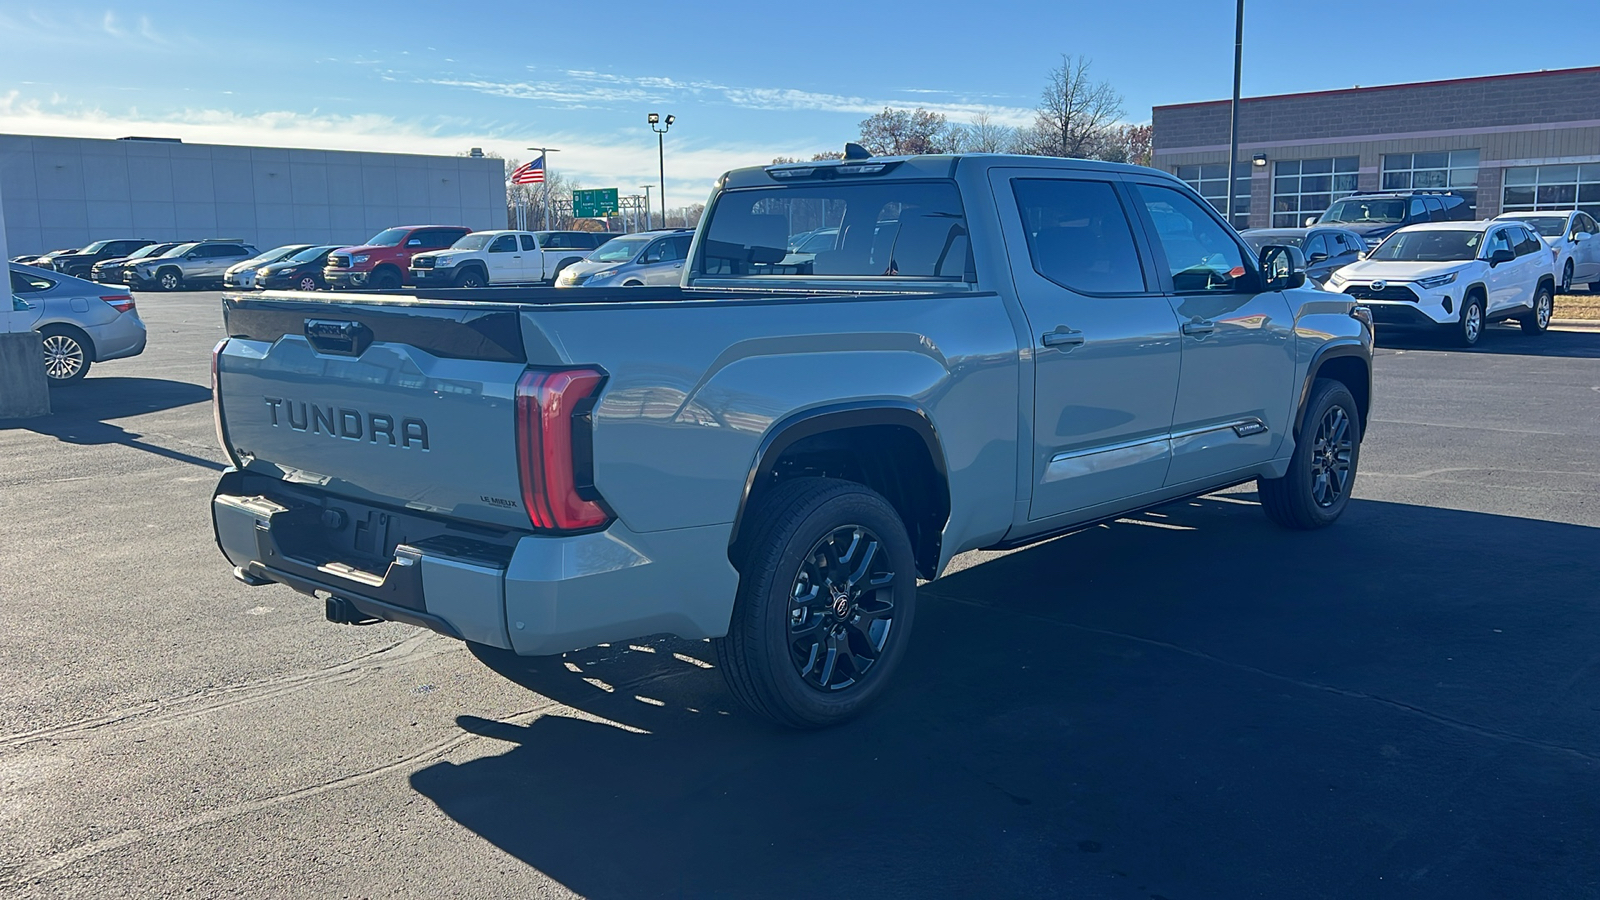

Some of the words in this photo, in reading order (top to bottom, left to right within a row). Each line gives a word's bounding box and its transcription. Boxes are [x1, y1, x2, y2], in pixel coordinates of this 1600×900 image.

[262, 395, 430, 452] TUNDRA
[480, 495, 491, 503] LE
[491, 497, 518, 508] MIEUX
